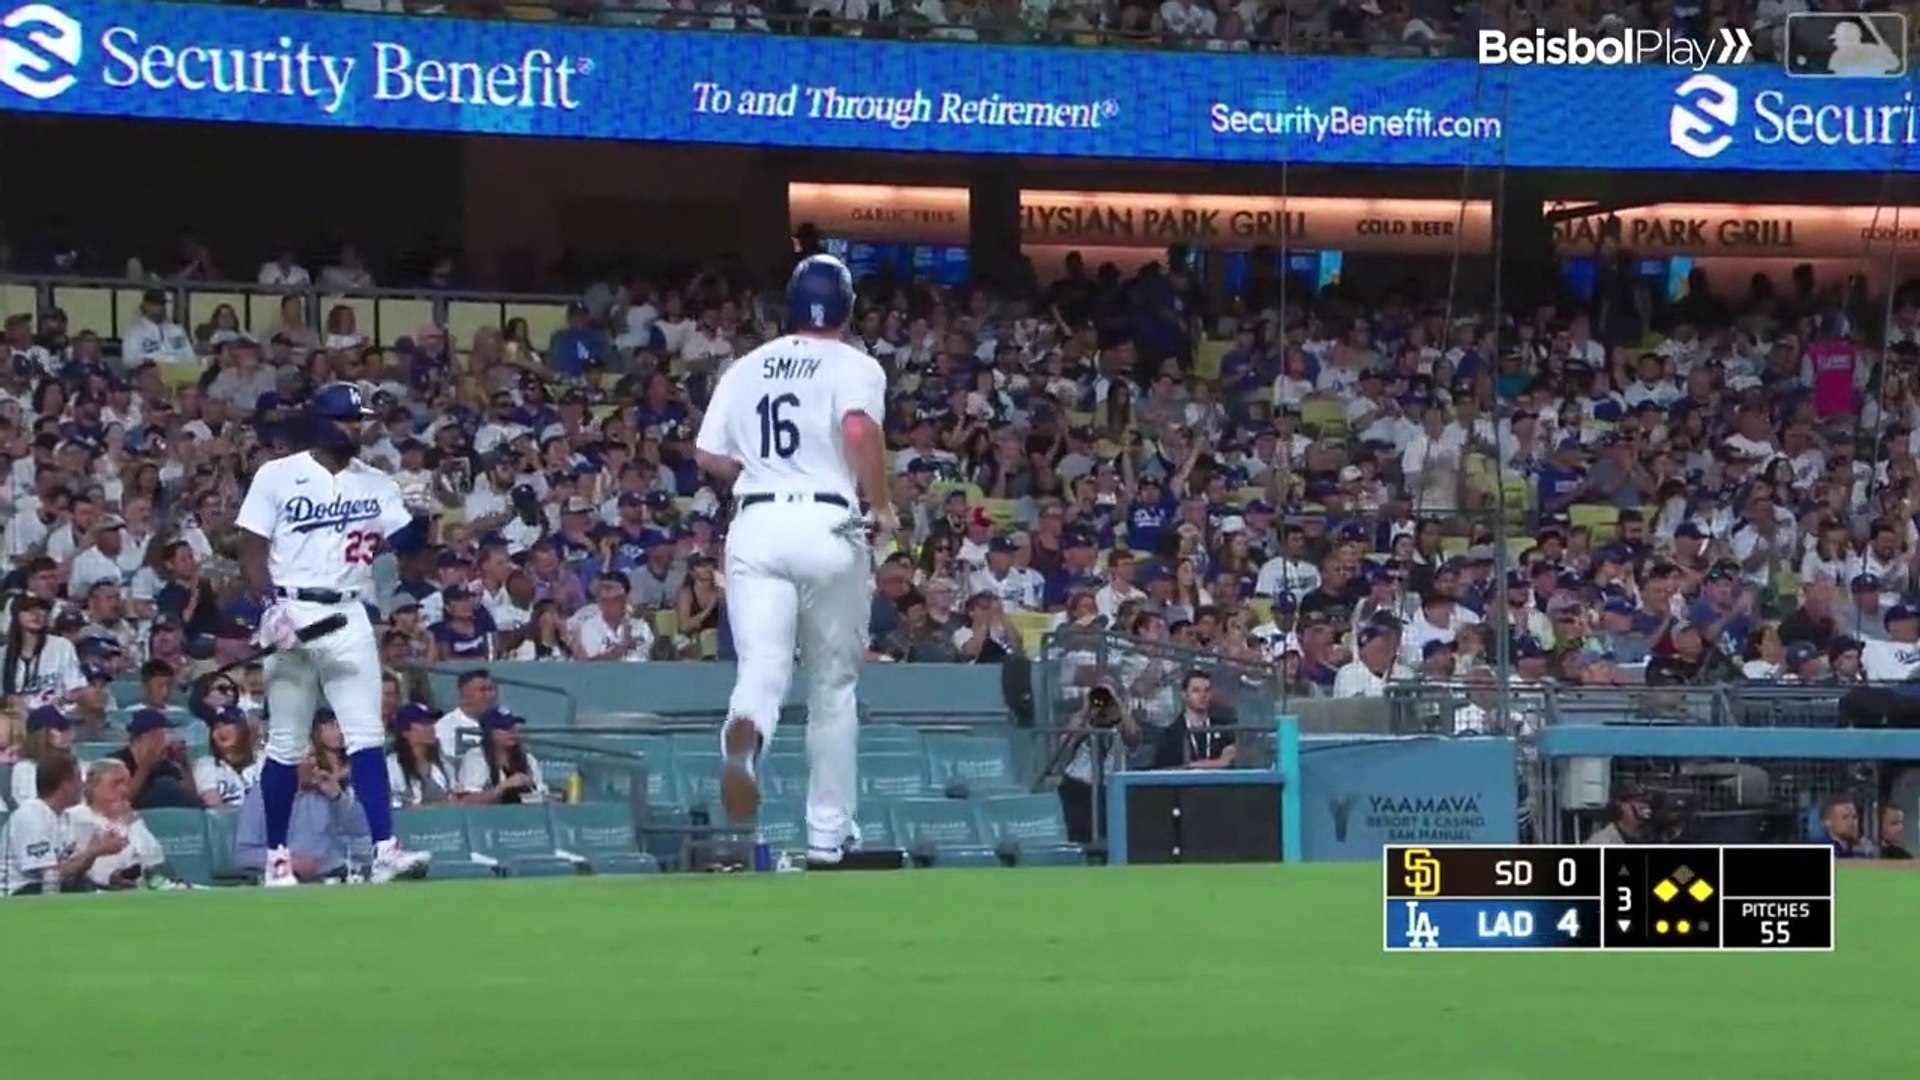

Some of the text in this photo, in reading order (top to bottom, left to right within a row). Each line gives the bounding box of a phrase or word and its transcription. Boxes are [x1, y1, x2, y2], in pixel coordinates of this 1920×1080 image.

[101, 26, 356, 114] Security
[692, 81, 732, 114] To
[736, 83, 799, 117] and
[805, 86, 932, 131] Through
[1210, 103, 1501, 142] SecurityBenefit.com
[1020, 205, 1305, 238] LYSIAN PARK GRILL
[1356, 218, 1454, 237] COLD BEER
[1633, 217, 1708, 246] PARK
[1716, 219, 1794, 247] GRILL
[763, 356, 823, 381] SMITH
[756, 391, 801, 460] 16
[285, 493, 383, 534] Dodgers
[345, 529, 383, 566] 23
[1366, 816, 1417, 827] RESORT
[1434, 816, 1486, 828] CASINO
[1388, 829, 1472, 841] SAN MANUEL
